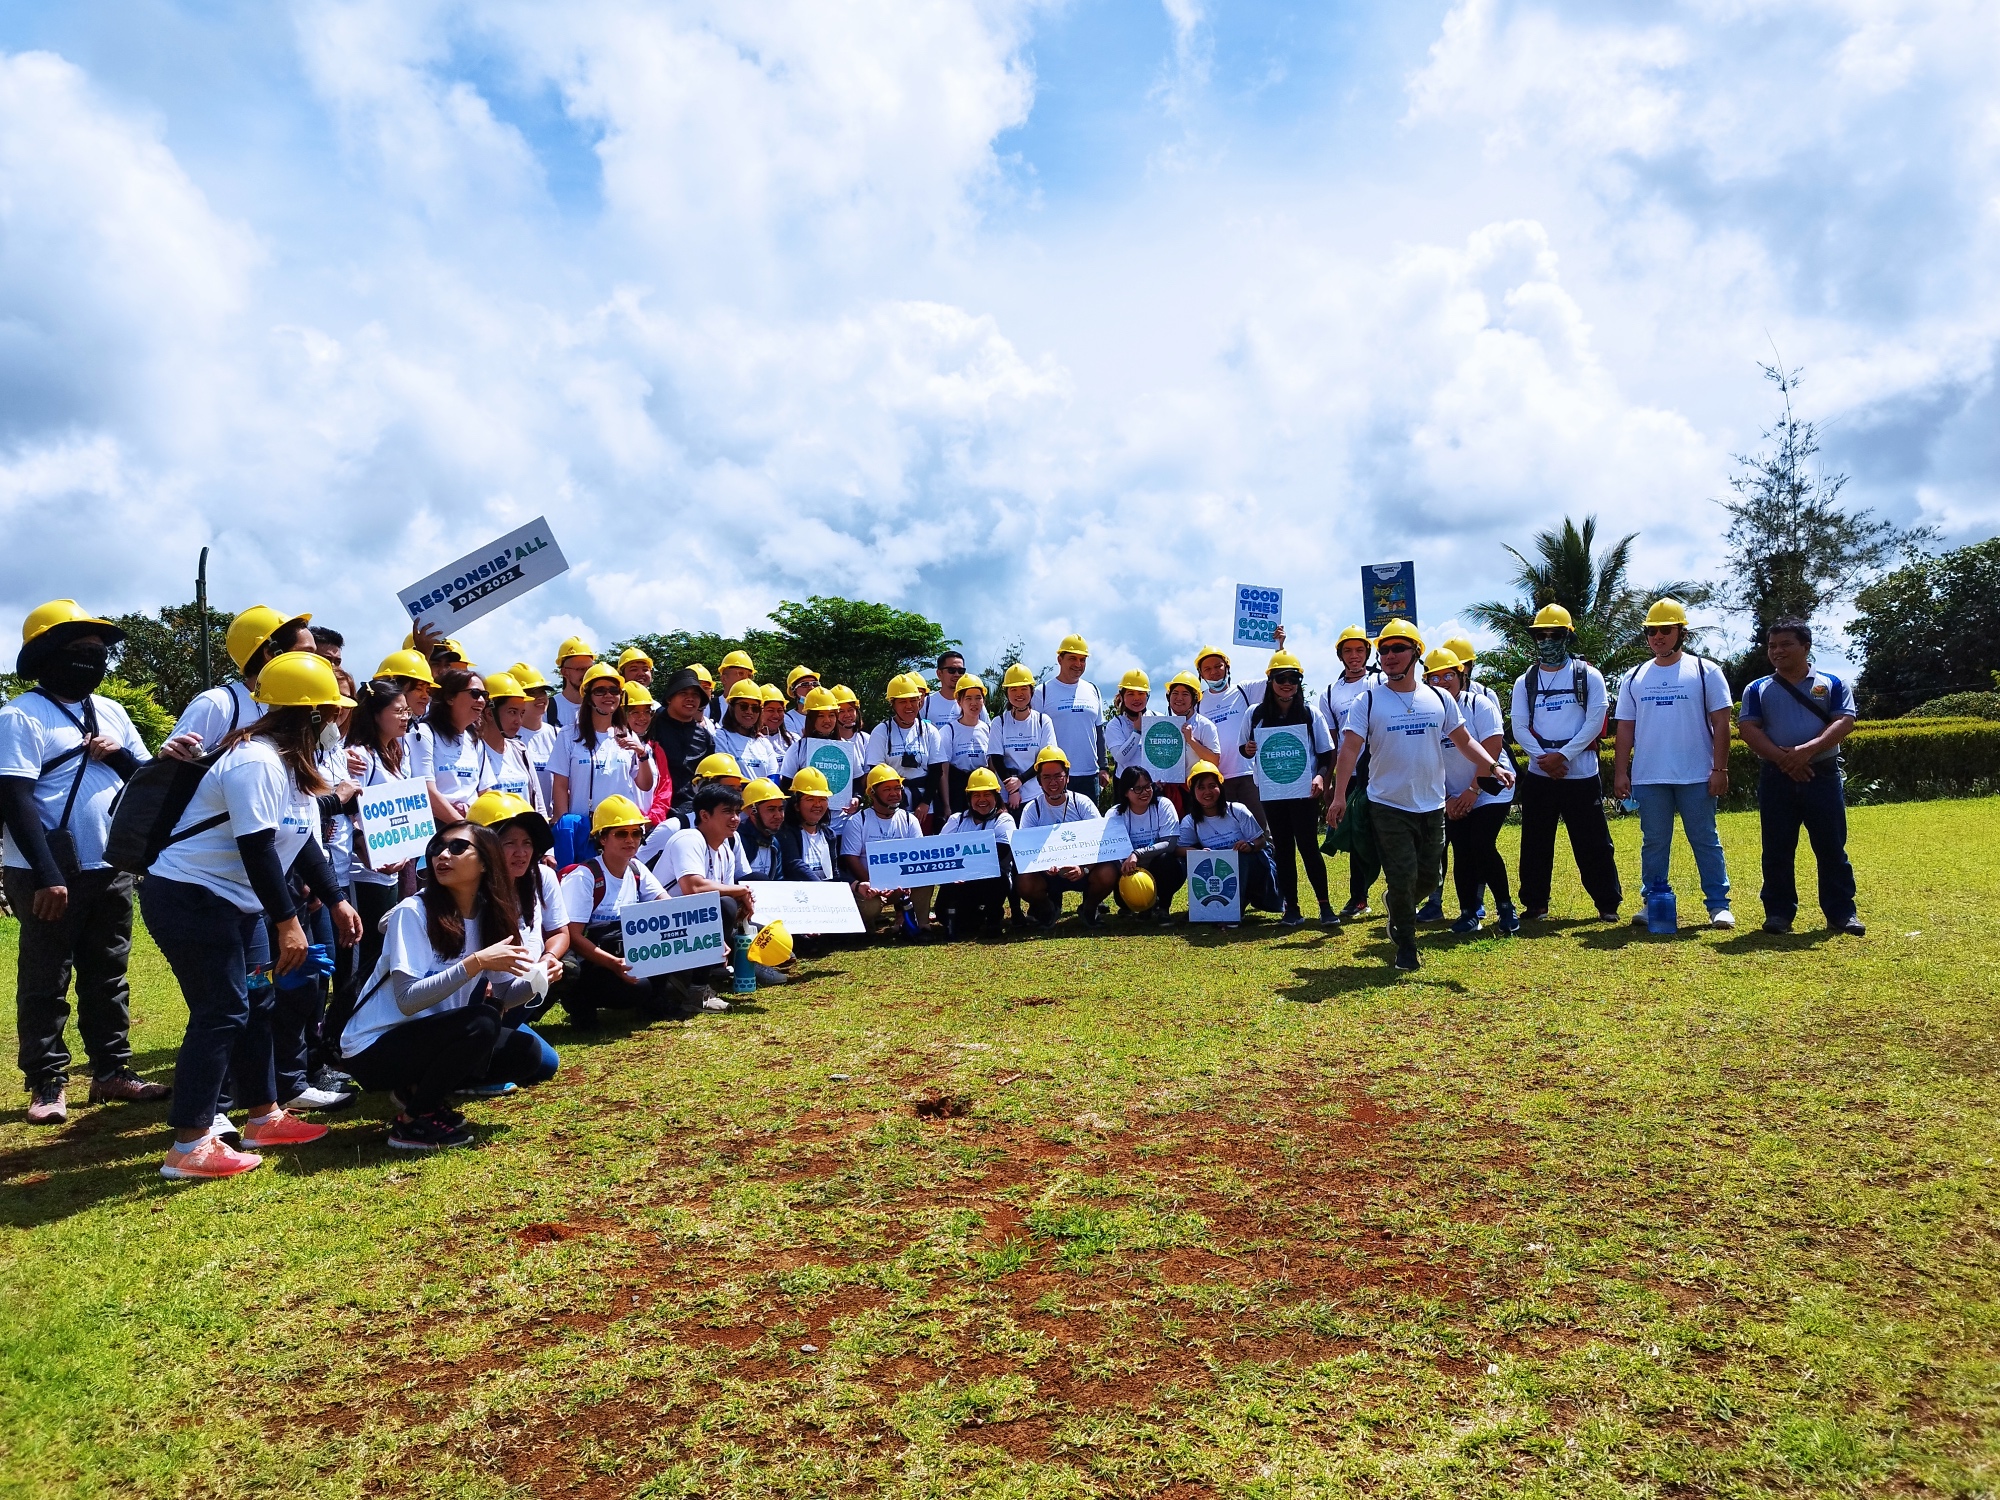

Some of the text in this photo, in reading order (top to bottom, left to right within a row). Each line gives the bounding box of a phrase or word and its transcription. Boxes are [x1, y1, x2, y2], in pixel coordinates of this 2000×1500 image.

[459, 571, 515, 606] DAY 2022
[1240, 588, 1279, 602] GOOD
[1240, 600, 1279, 614] TIMES
[1238, 618, 1278, 631] GOOD
[1238, 629, 1276, 643] PLACE
[1265, 749, 1300, 759] TERROIR
[814, 761, 846, 771] TERROIR
[362, 792, 428, 820] GOOD TIMES
[368, 820, 435, 850] GOOD PLACE
[1014, 846, 1046, 857] Pernod
[1048, 842, 1078, 853] Ricard
[1079, 836, 1129, 849] Philippines
[869, 843, 991, 866] RESPONSIB'ALL
[907, 861, 957, 873] DAY 2022
[625, 906, 719, 936] GOOD TIMES
[663, 931, 680, 939] FROM
[627, 932, 722, 963] GOOD PLACE
